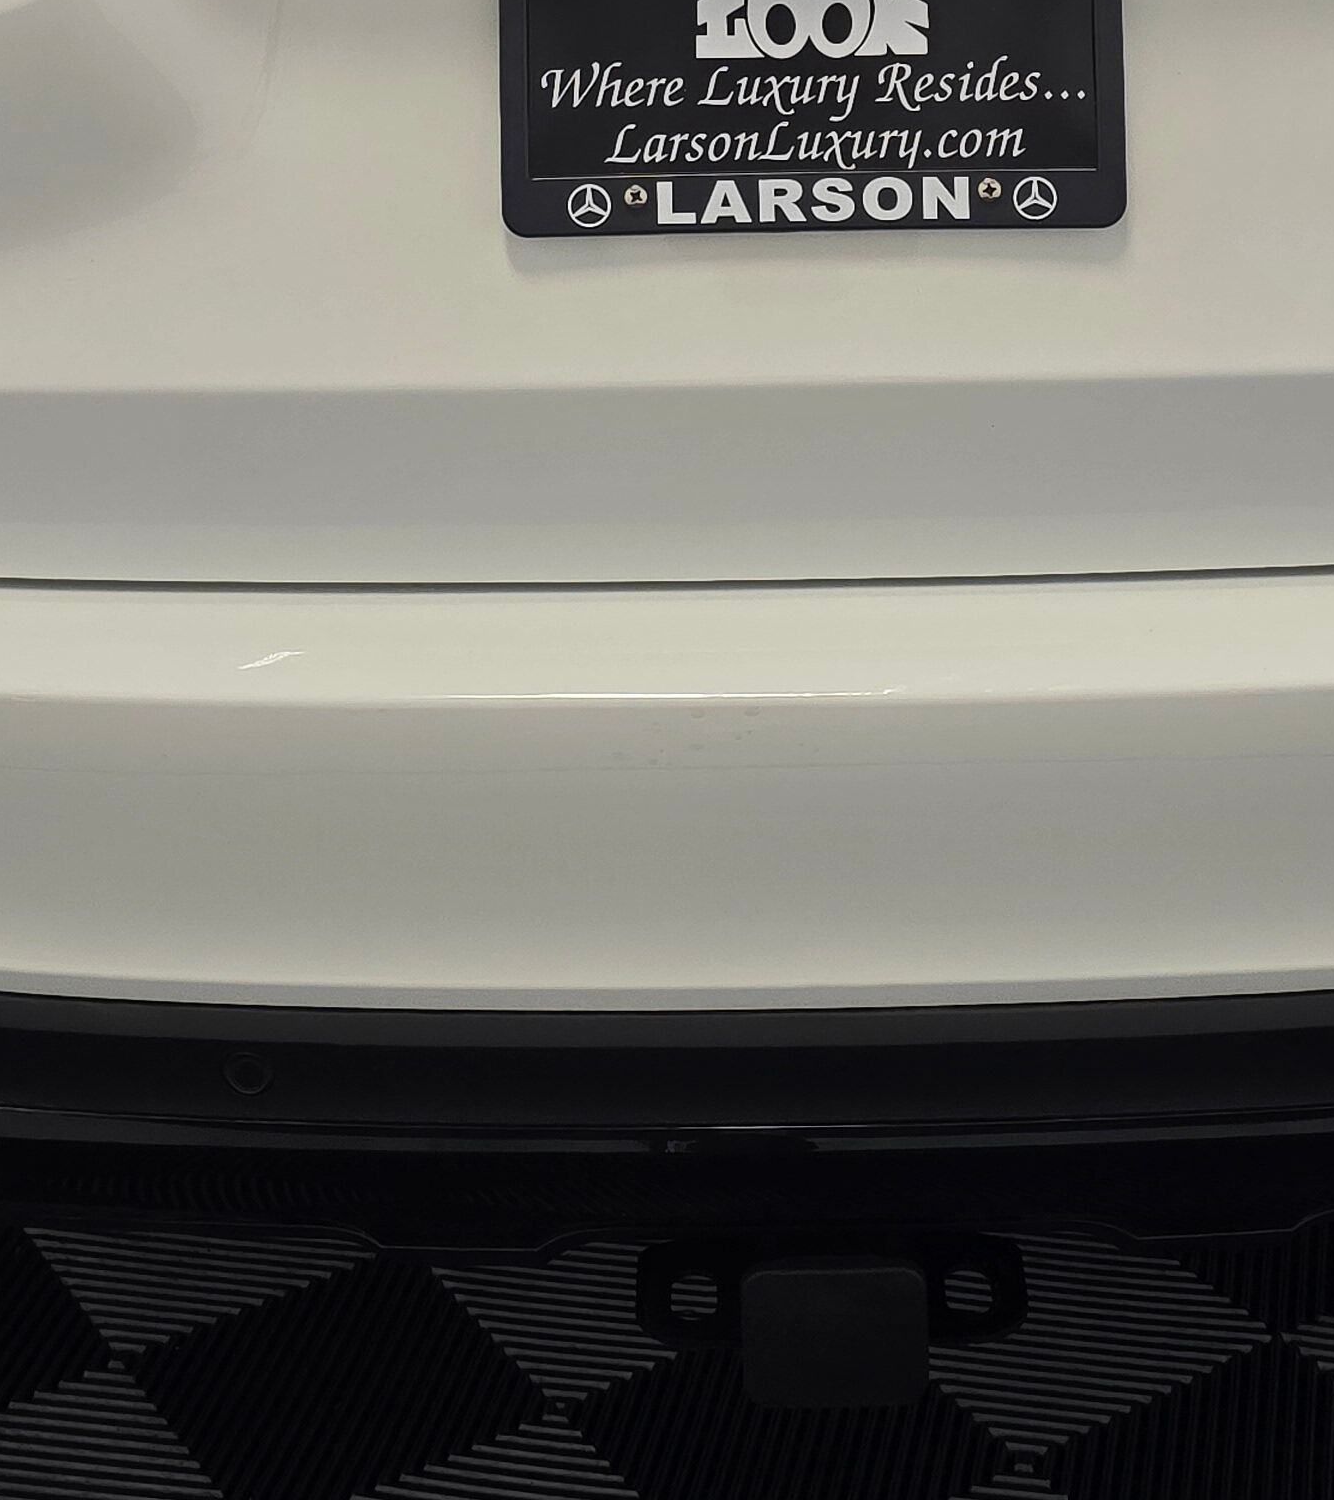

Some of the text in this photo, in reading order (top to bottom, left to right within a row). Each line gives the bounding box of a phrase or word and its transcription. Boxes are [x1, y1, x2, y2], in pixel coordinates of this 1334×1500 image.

[540, 55, 1086, 122] Where Luxury Resides...
[603, 121, 1026, 171] LarsonLuxury.com
[656, 176, 971, 225] LARSON
